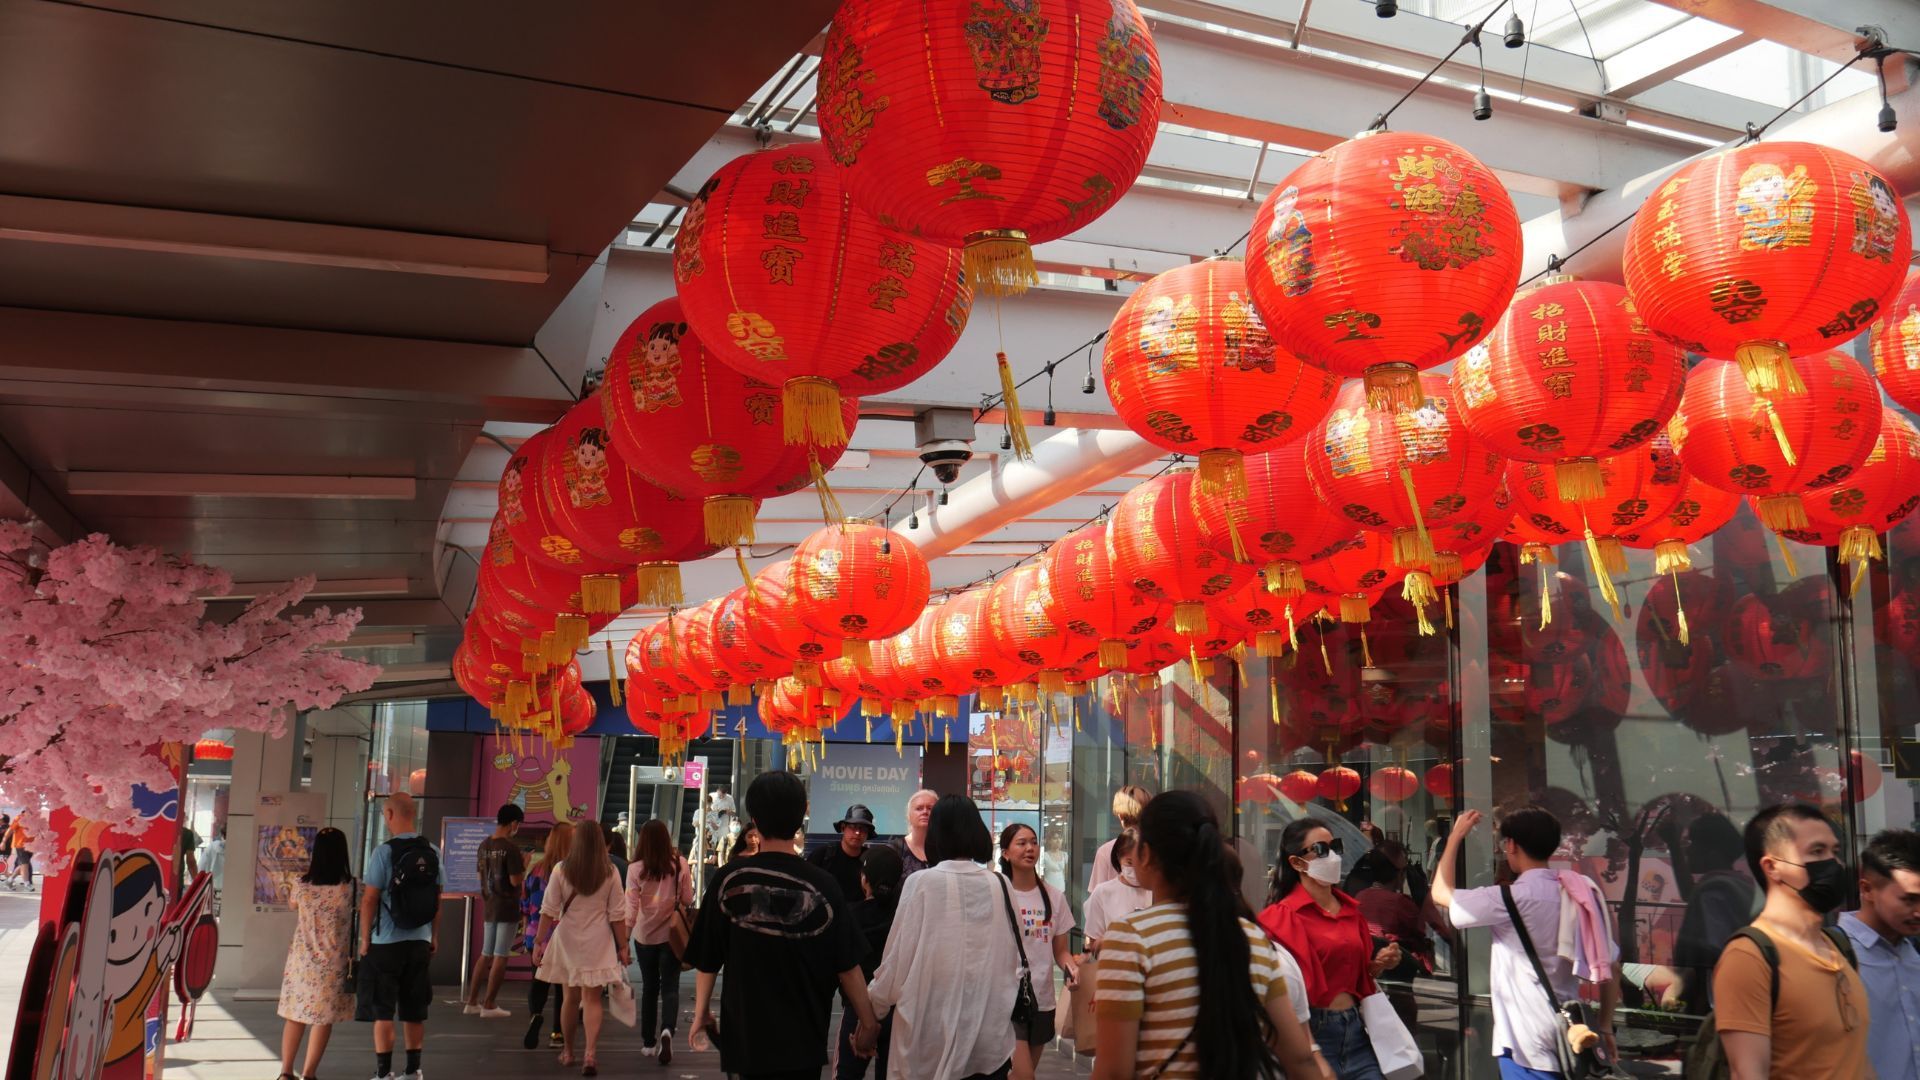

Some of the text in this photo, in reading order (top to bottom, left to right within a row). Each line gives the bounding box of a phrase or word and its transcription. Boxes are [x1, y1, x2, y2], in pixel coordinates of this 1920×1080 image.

[760, 155, 816, 286] 招財進寶
[1652, 177, 1691, 282] 金玉滿堂
[1529, 302, 1577, 400] 招財進寶
[1073, 539, 1096, 602] 招財進寶
[821, 765, 909, 781] MOVIE DAY
